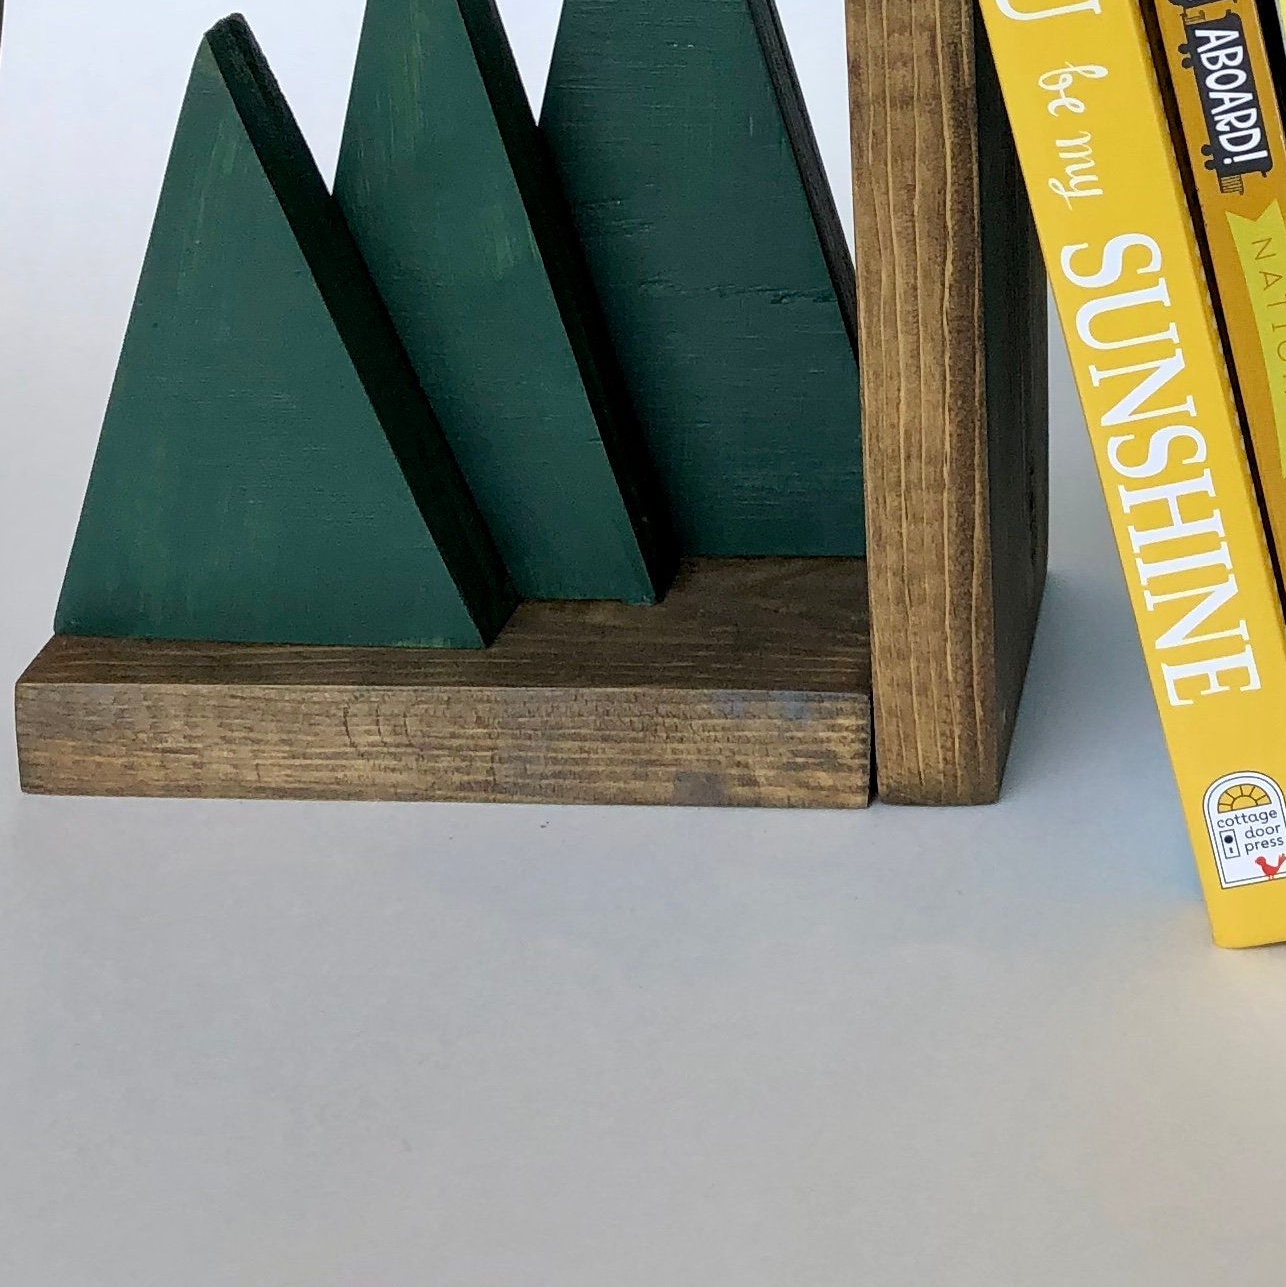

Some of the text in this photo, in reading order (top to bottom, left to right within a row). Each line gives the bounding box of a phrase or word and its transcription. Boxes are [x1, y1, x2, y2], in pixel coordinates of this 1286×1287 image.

[1037, 61, 1109, 118] be
[1195, 27, 1268, 167] ABOARD!
[1048, 130, 1104, 210] my
[1060, 232, 1261, 707] SUNSHINE
[1216, 809, 1278, 828] cottage
[1244, 822, 1281, 840] door
[1244, 834, 1284, 856] press
